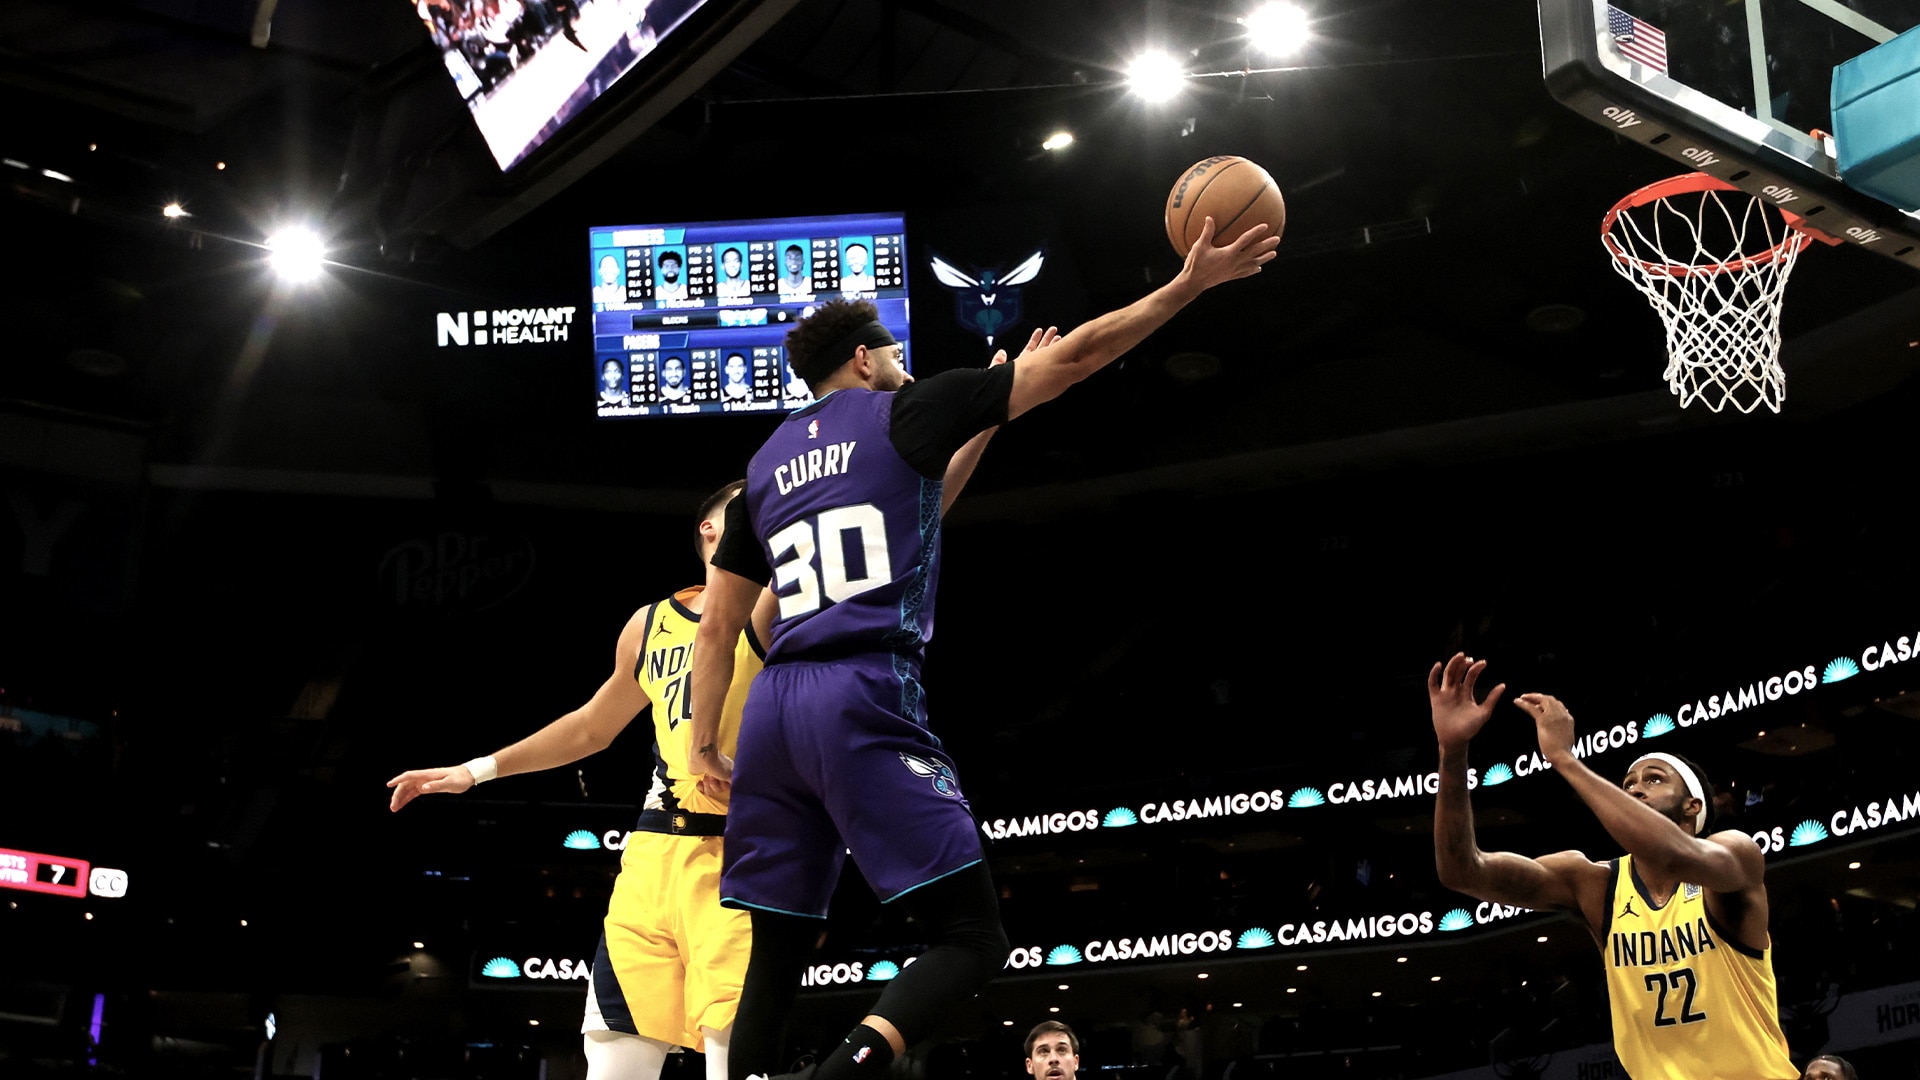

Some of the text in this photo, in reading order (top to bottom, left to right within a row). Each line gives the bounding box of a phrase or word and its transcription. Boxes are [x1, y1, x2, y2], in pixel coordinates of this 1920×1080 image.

[1602, 105, 1641, 129] ally
[1682, 146, 1719, 168] ally
[1762, 184, 1799, 205] ally
[1846, 226, 1881, 245] ally
[492, 306, 576, 327] NOVANT
[493, 325, 568, 345] HEALTH
[774, 440, 856, 496] CURRY
[767, 501, 893, 621] 30
[981, 809, 1098, 840] ASAMIGOS
[1139, 789, 1283, 825] CASAMIGOS
[1327, 768, 1478, 804] CASAMIGS
[1677, 665, 1817, 728] CASAMIGOS
[50, 863, 66, 885] 7
[1084, 929, 1232, 963] CASAMIGOS
[1277, 911, 1434, 946] CASAMIGOS
[1643, 967, 1707, 1028] 22
